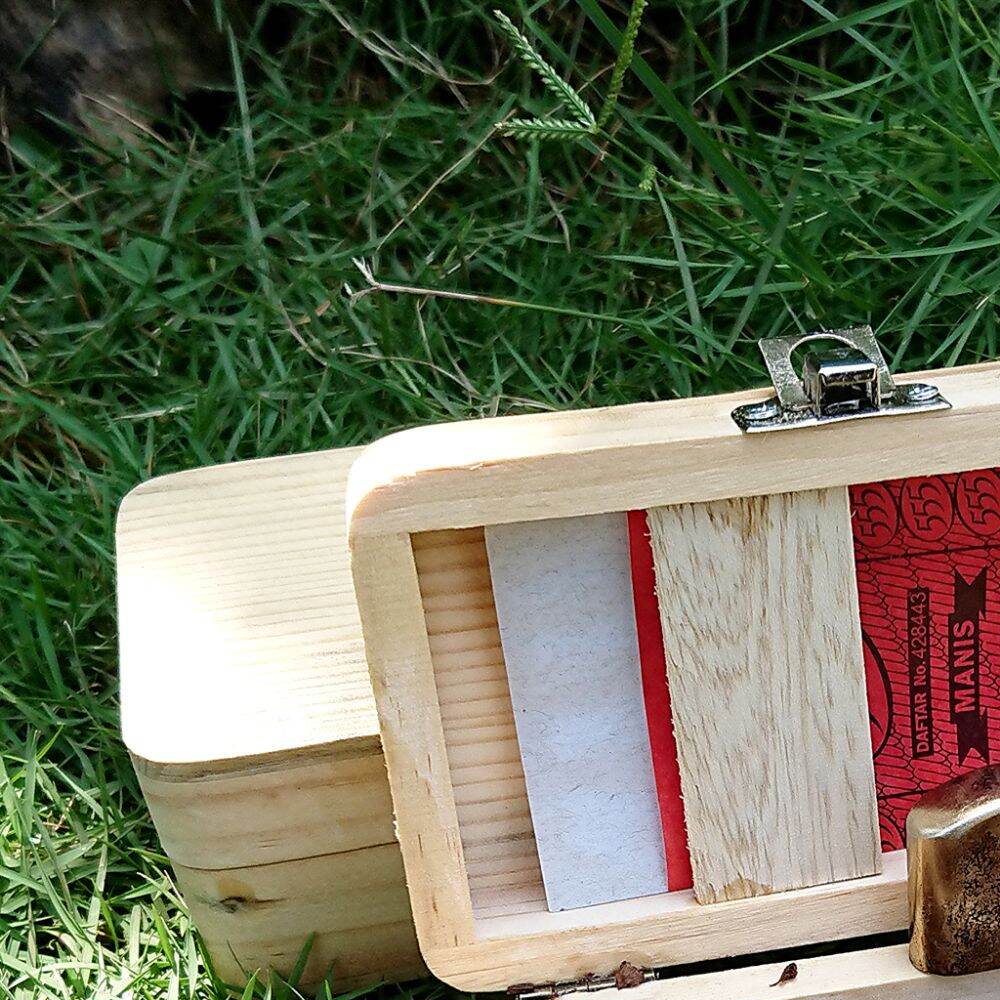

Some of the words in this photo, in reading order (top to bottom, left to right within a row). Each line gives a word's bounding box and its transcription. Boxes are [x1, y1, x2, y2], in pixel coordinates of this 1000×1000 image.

[906, 483, 949, 531] 555
[952, 620, 976, 713] MANIS
[913, 692, 930, 753] DAFTAR
